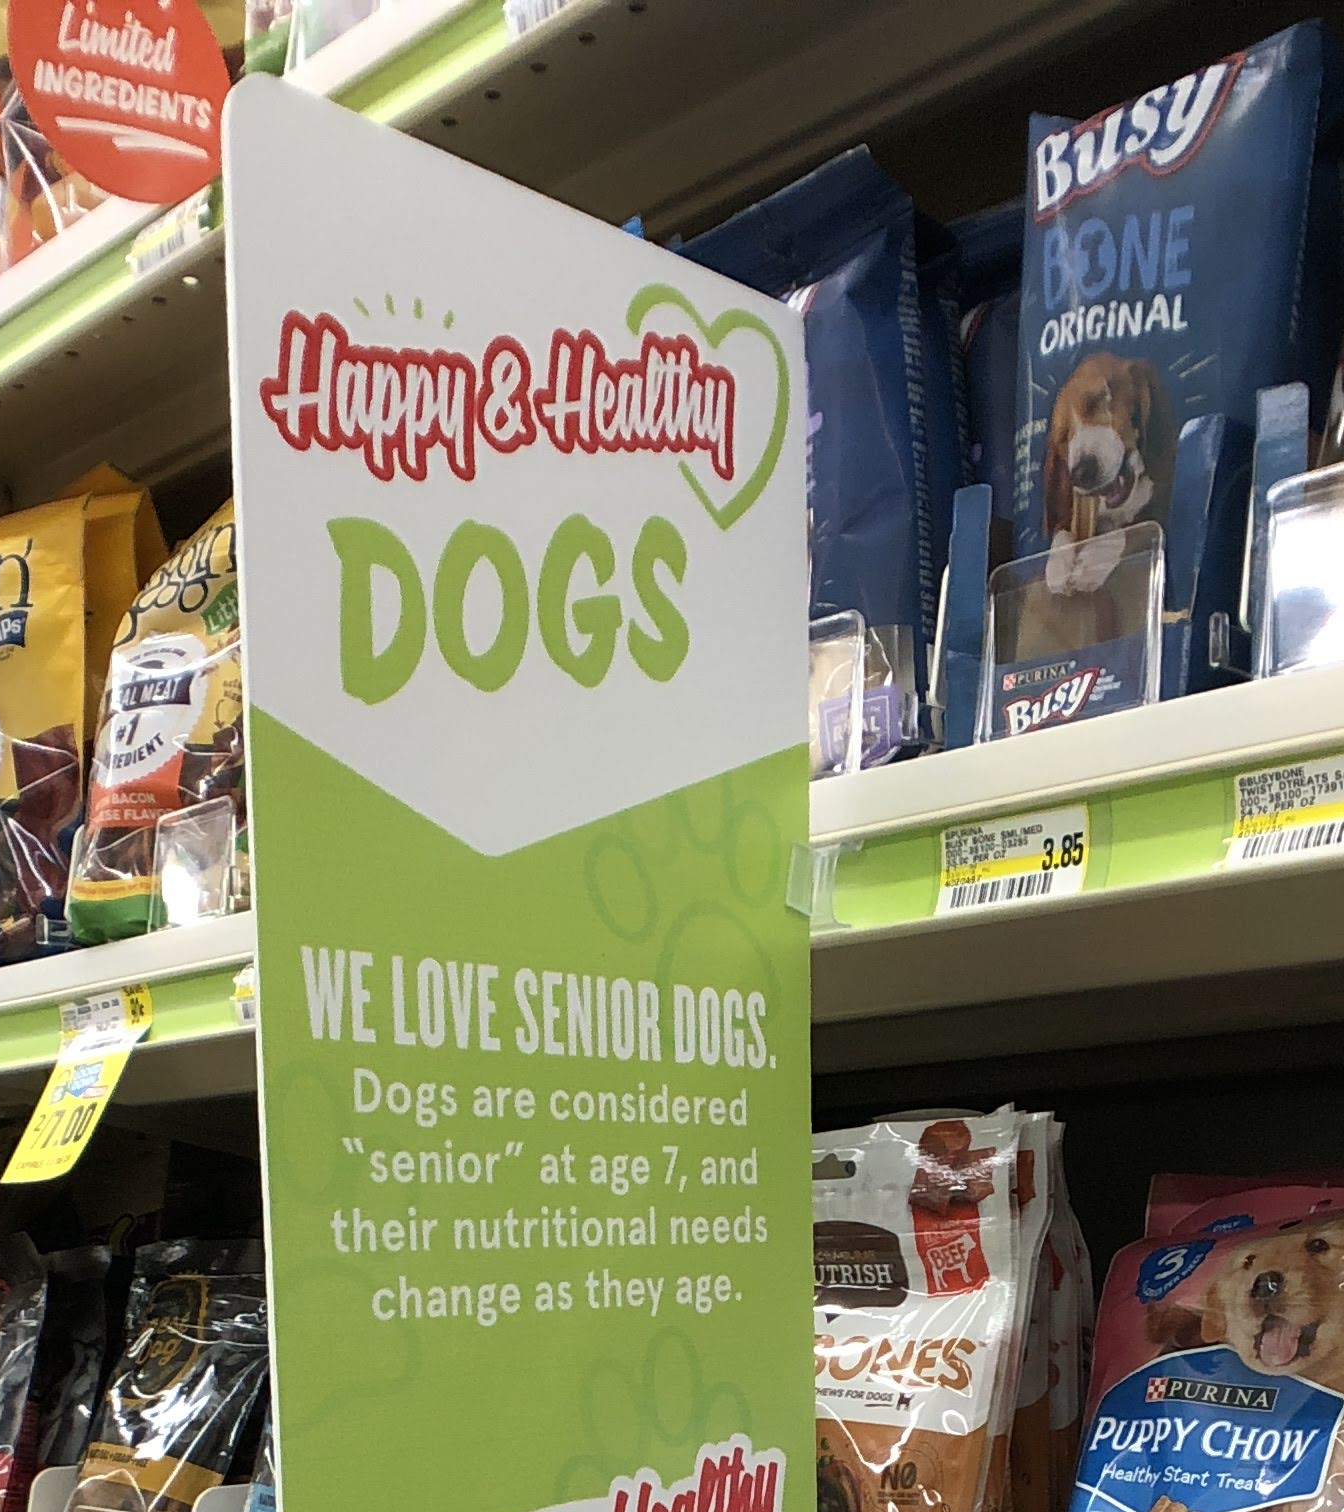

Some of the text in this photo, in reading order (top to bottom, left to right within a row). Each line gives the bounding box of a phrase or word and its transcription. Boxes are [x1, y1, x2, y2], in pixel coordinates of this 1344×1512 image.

[56, 3, 176, 75] Limited
[32, 58, 213, 131] INGREDIENTS
[1036, 58, 1233, 214] Busy
[1042, 206, 1196, 312] BONE
[1039, 295, 1189, 355] ORIGINAL
[260, 310, 736, 482] Happy & Healthy
[325, 512, 691, 706] DOGS
[1004, 669, 1096, 736] Busy
[1239, 772, 1329, 799] TWIST DTREATS
[1041, 831, 1085, 871] 3.85
[299, 945, 778, 1070] WE LOVE SENIOR DOGS.
[351, 1068, 748, 1128] Dogs are considered
[342, 1135, 759, 1196] "senior" at age 7, and
[330, 1205, 769, 1253] their nutritional needs
[372, 1268, 743, 1327] change as they age.
[1167, 1381, 1271, 1408] PURINA
[1088, 1415, 1321, 1463] PUPPY CHOW
[1102, 1462, 1162, 1488] Healthy
[1162, 1466, 1210, 1488] Start
